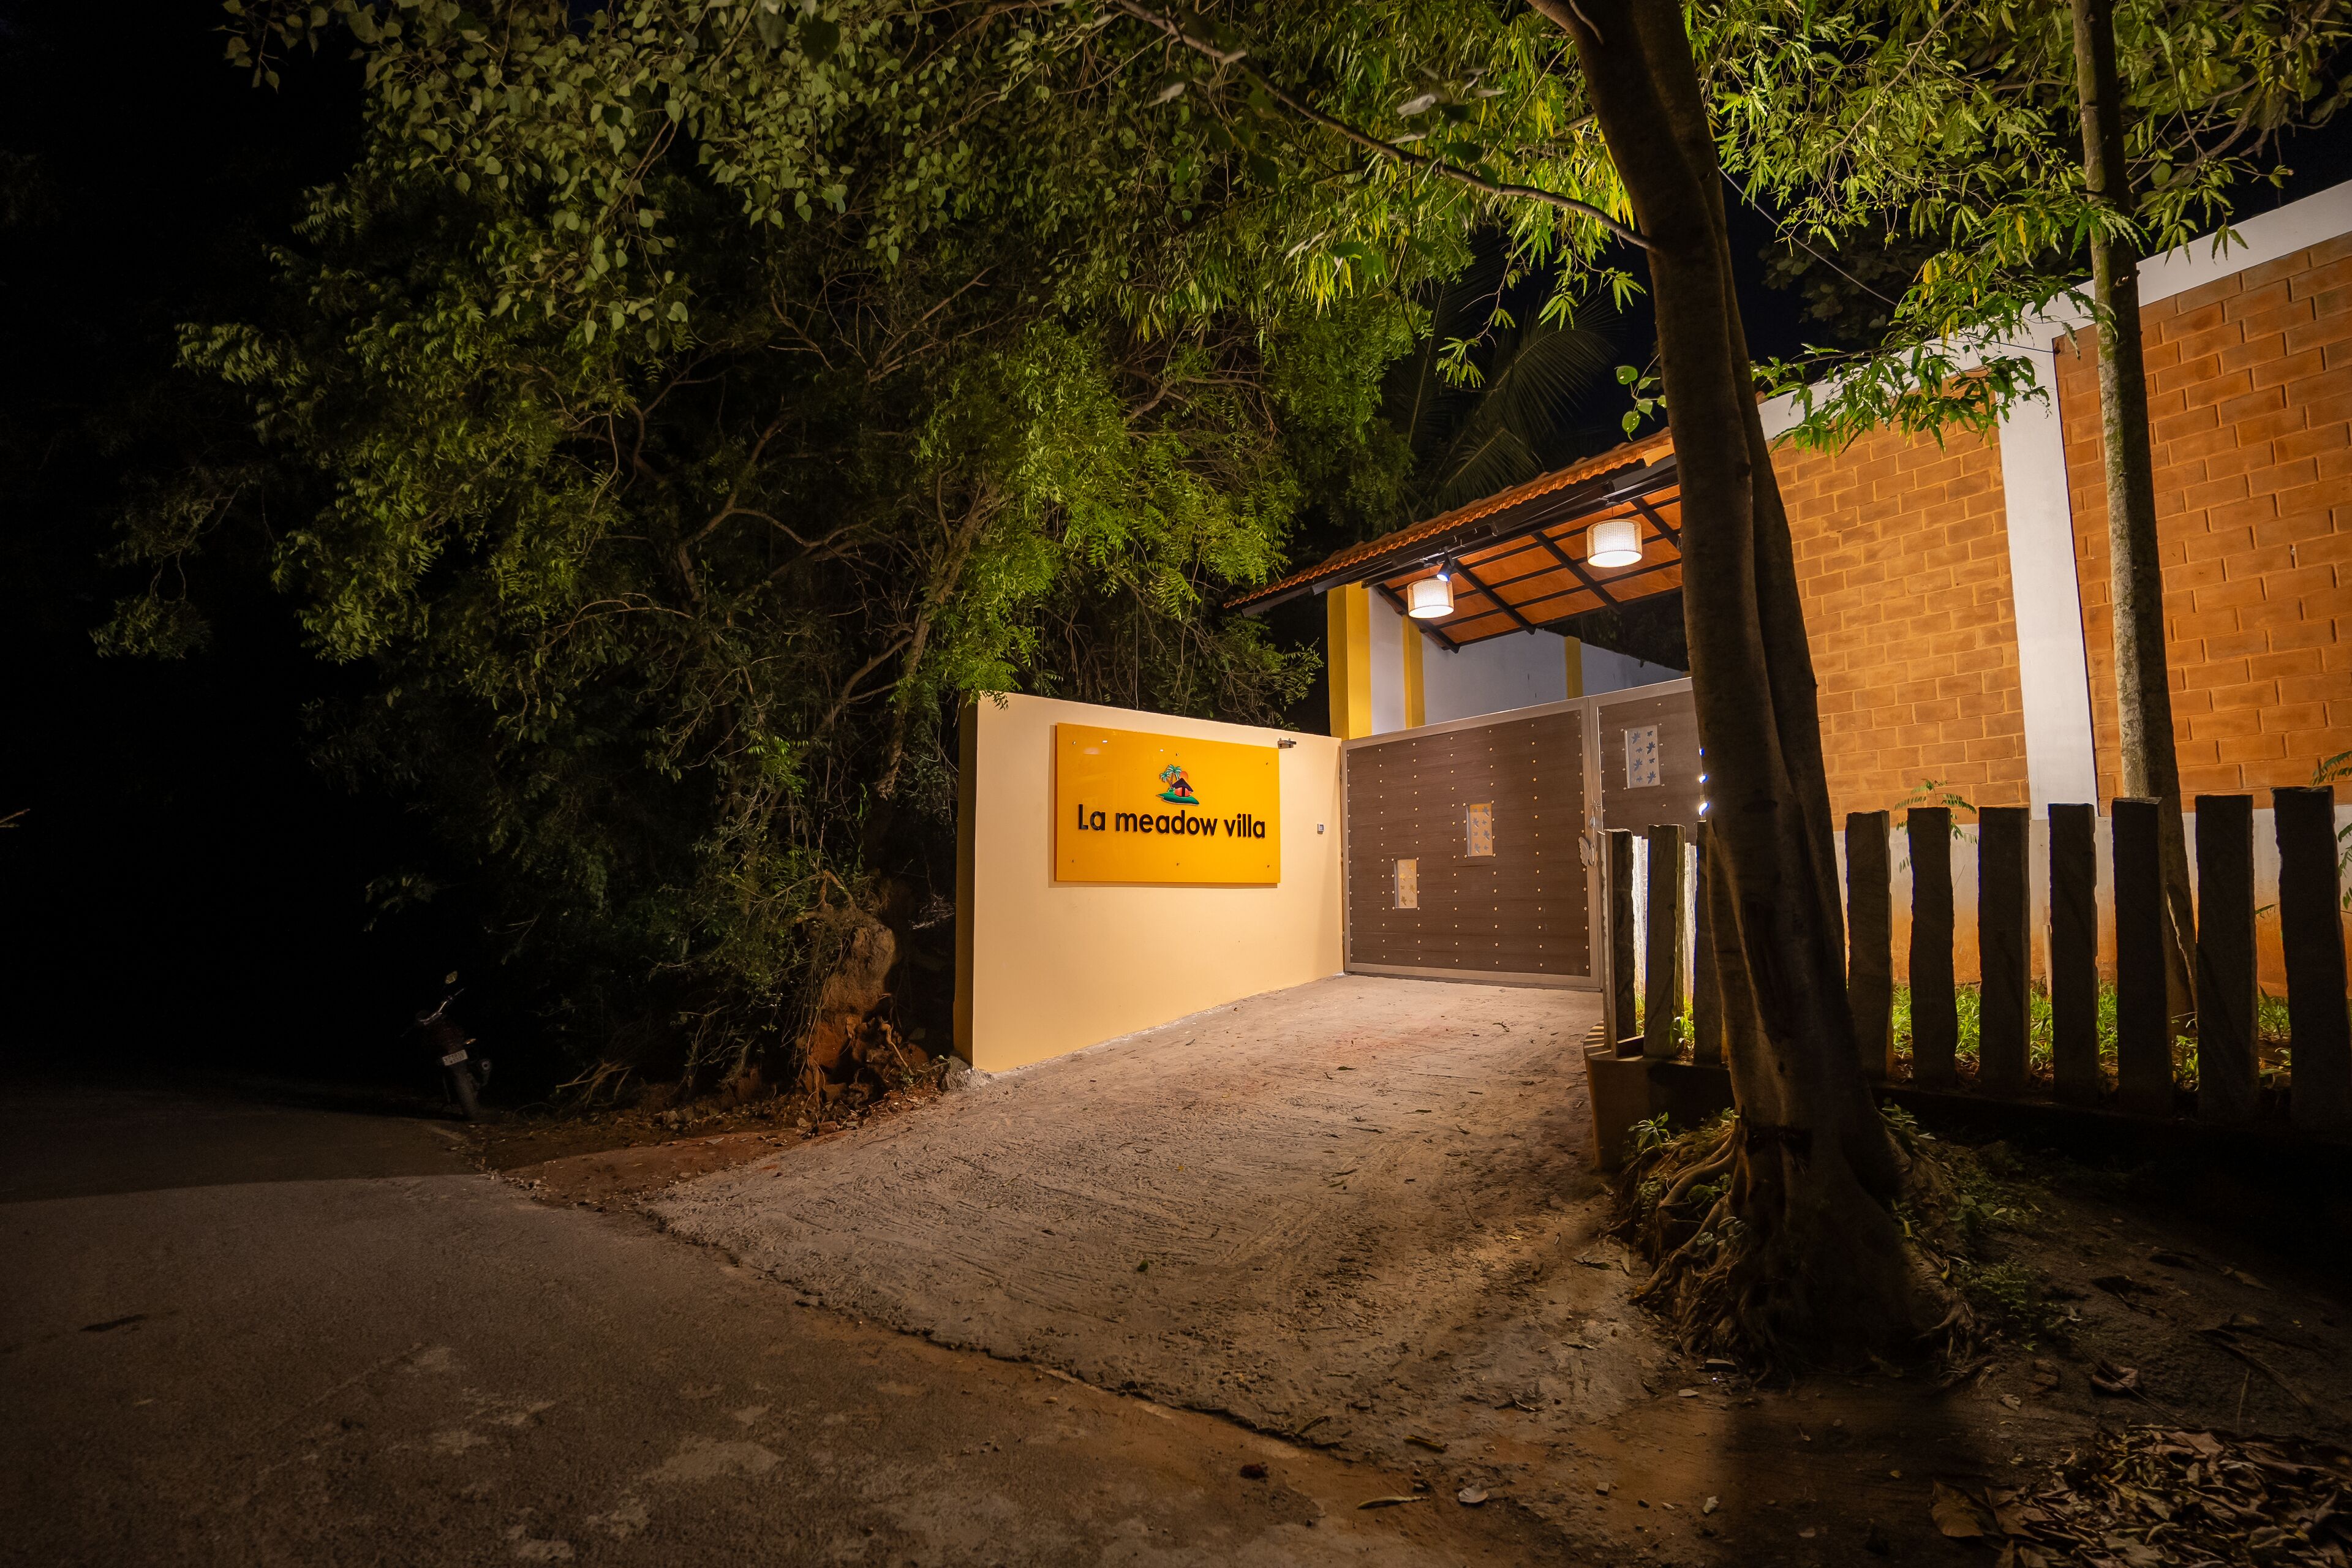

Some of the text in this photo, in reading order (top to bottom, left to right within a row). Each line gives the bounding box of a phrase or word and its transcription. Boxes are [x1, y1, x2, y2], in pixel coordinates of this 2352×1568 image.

[1078, 804, 1265, 839] La meadow villa
